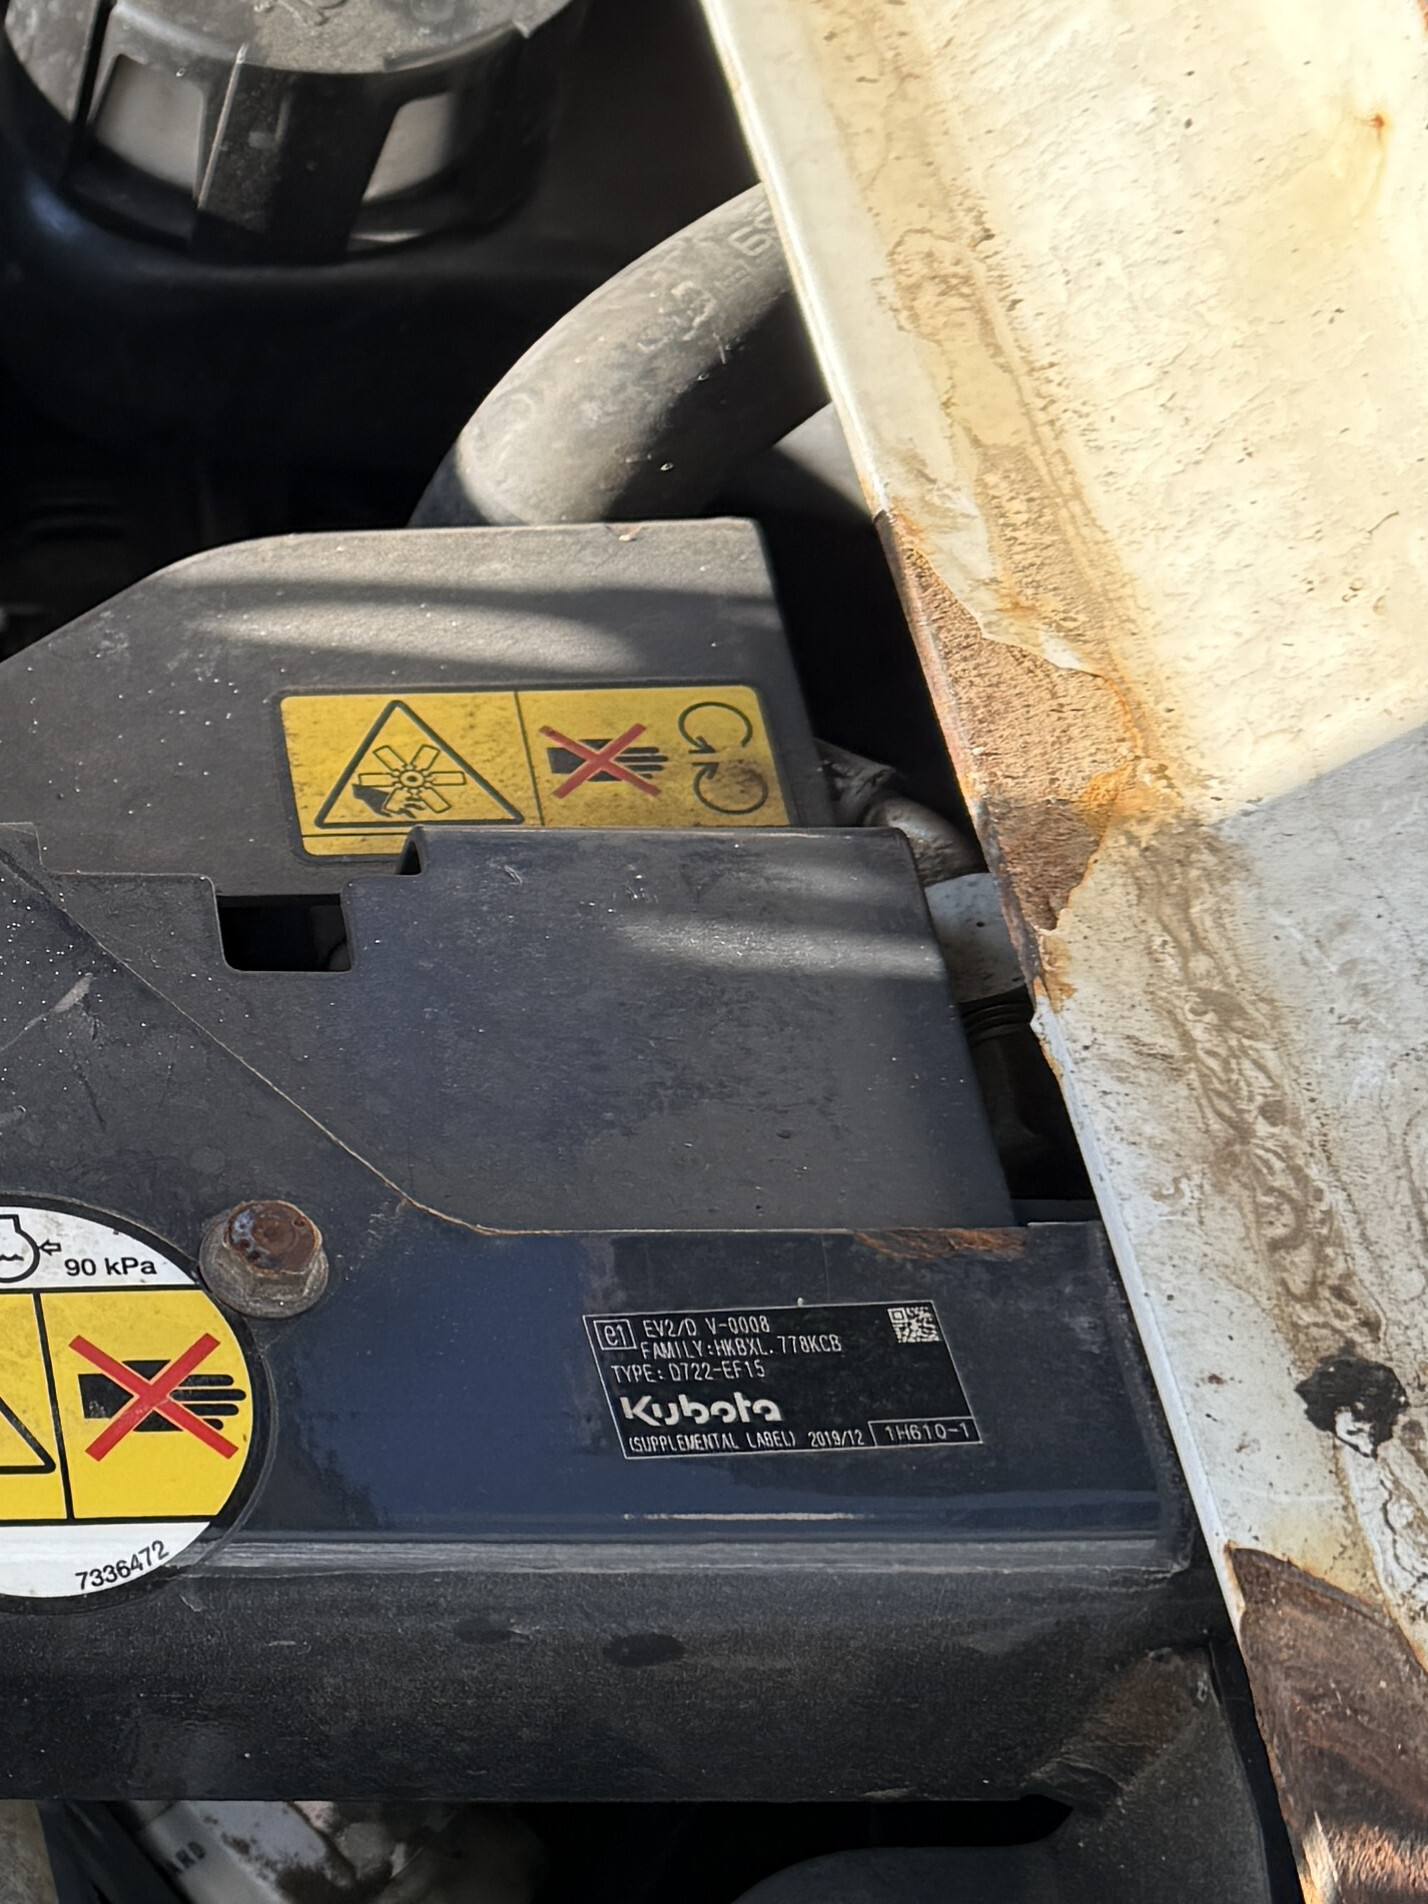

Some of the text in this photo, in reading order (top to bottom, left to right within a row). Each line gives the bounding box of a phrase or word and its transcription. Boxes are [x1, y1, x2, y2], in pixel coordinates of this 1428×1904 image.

[65, 1256, 158, 1278] 90 kPa
[667, 1359, 768, 1382] D722-EF15
[618, 1389, 784, 1428] Kubota
[627, 1428, 866, 1454] (SUPPLEMENTAL LABEL) 2019/12
[882, 1421, 971, 1442] 1H610-1
[74, 1540, 171, 1591] 7336472
